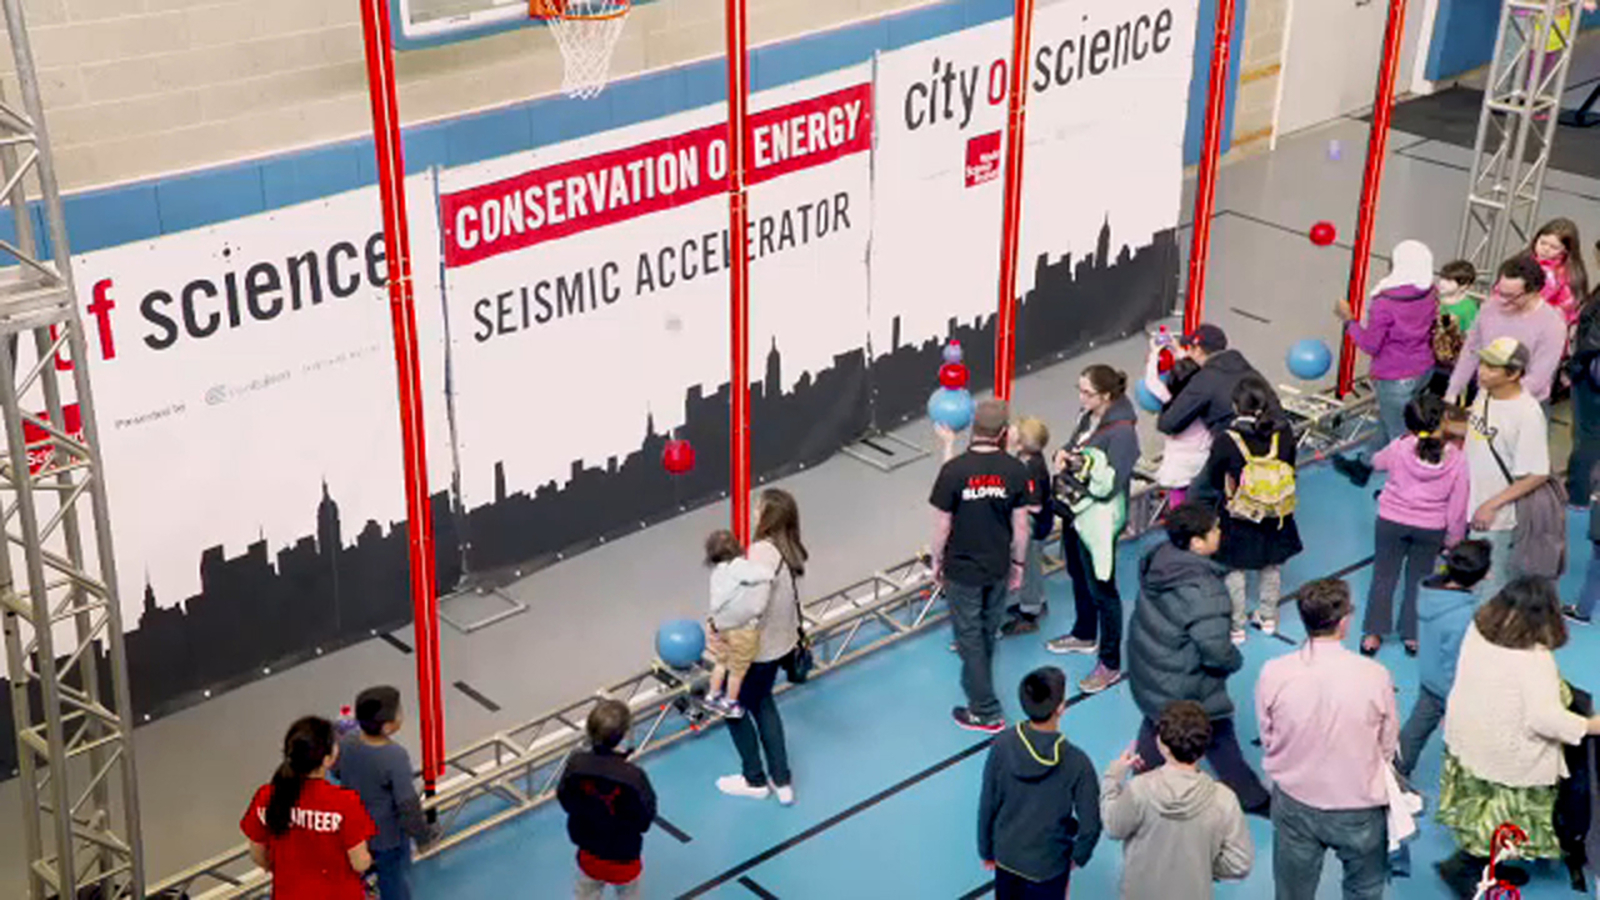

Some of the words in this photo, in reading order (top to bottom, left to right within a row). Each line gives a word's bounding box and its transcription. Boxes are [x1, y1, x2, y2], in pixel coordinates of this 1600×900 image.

[904, 56, 980, 131] city
[987, 58, 1008, 106] o
[1032, 8, 1173, 93] science
[454, 146, 699, 250] CONSERVATION
[707, 138, 728, 181] O
[753, 99, 862, 169] ENERGY
[139, 231, 387, 351] science
[473, 261, 620, 343] SEISMIC
[256, 805, 343, 833] VUNTEER
